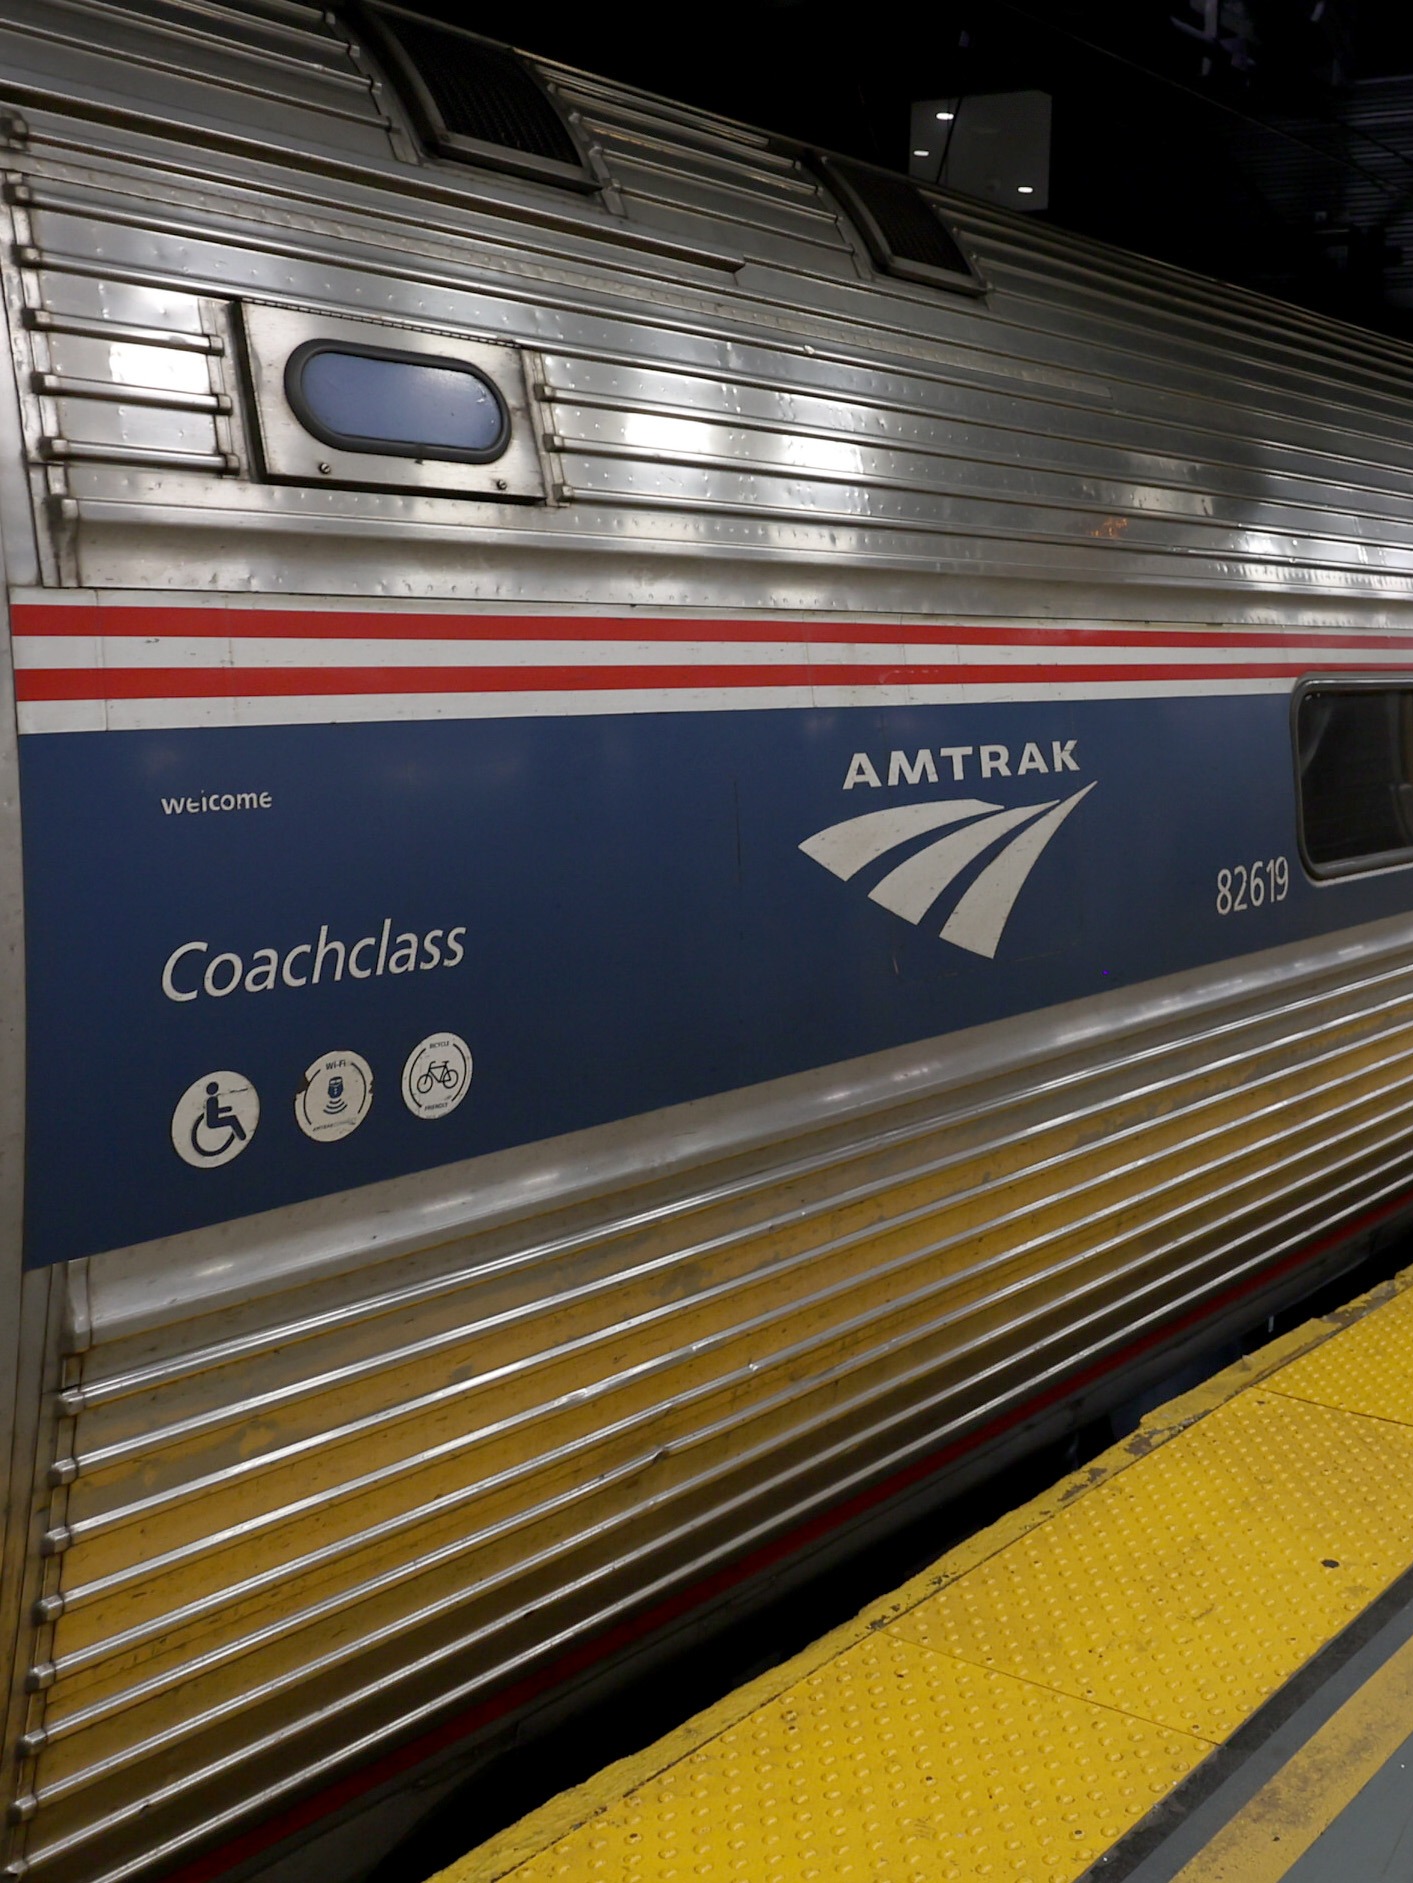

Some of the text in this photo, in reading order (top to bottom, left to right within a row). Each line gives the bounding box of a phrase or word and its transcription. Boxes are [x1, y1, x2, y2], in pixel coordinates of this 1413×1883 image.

[842, 739, 1081, 790] AMTRAK
[1215, 855, 1290, 916] 82619
[160, 917, 467, 1003] Coachclass
[325, 1059, 347, 1071] Wi-Fi
